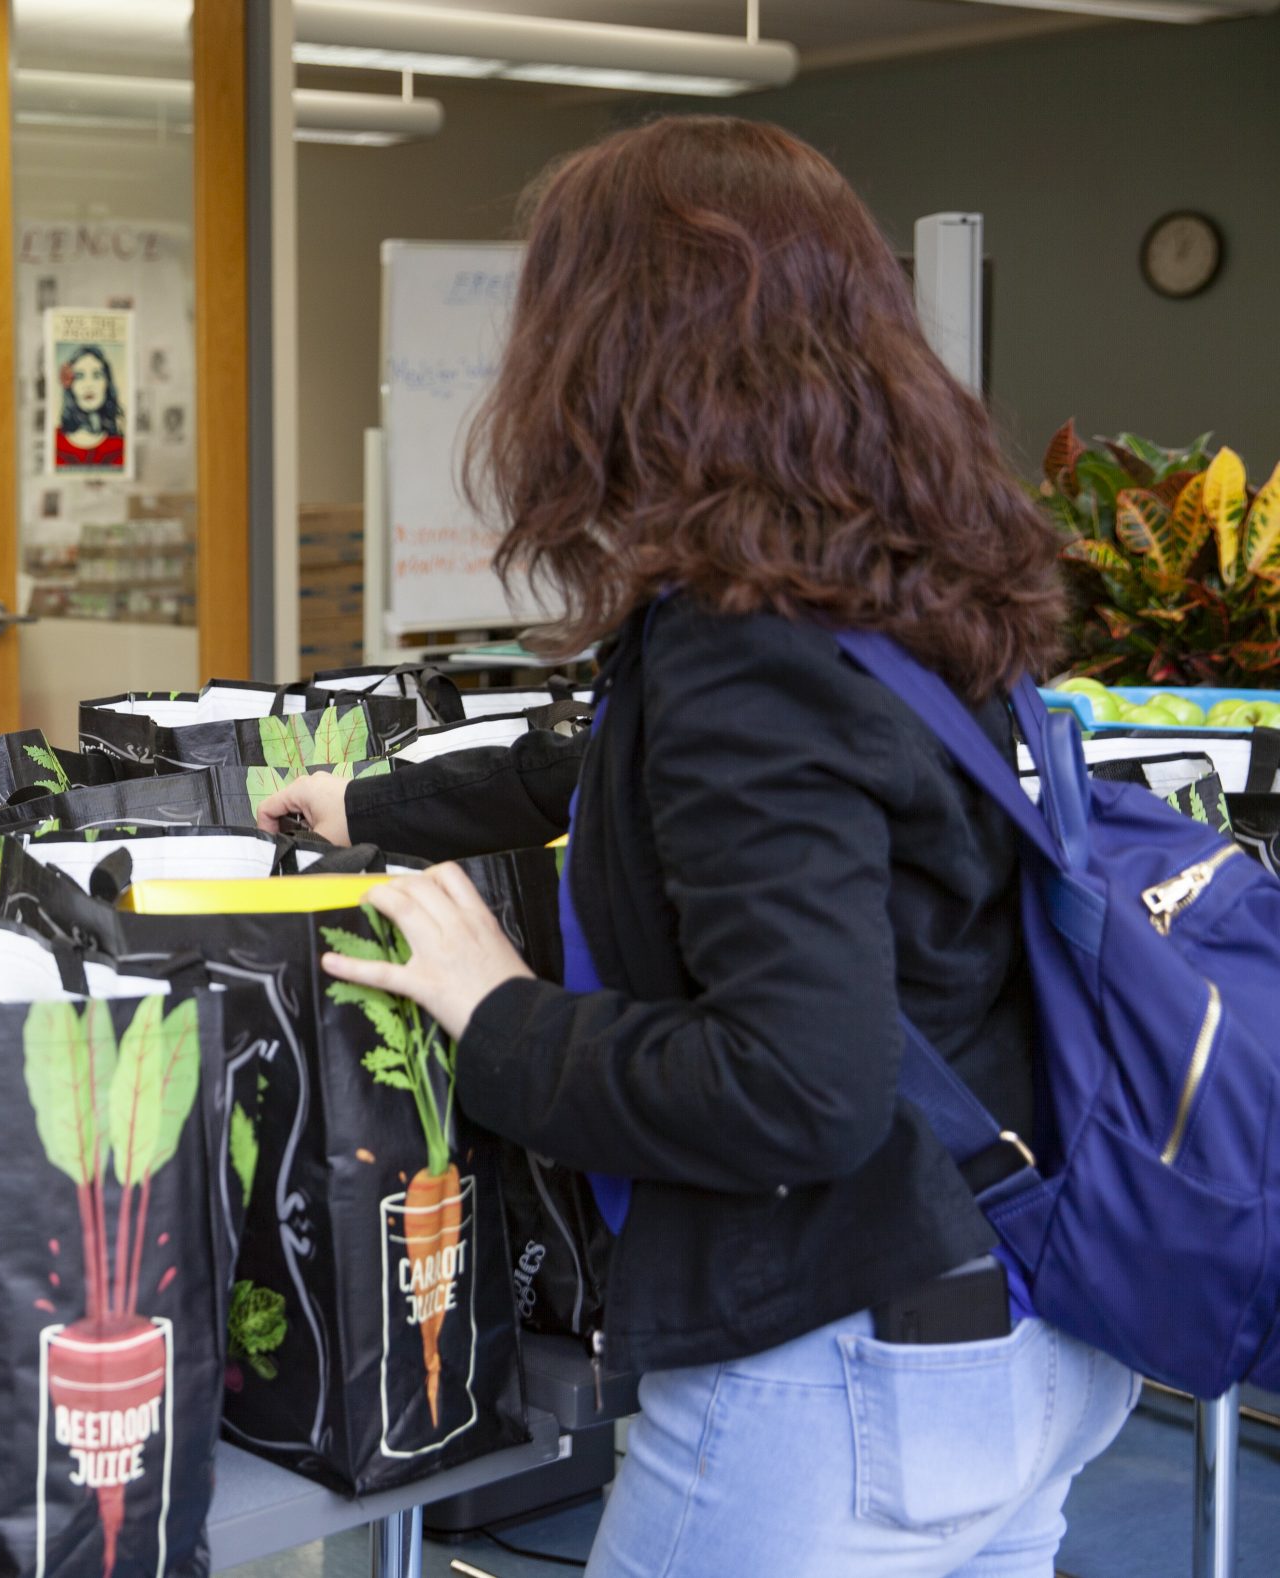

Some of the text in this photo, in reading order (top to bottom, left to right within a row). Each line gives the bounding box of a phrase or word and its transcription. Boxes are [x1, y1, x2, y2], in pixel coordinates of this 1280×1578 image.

[399, 1239, 467, 1293] CARROT
[407, 1281, 457, 1325] JUICE
[55, 1396, 161, 1448] BEETROOT
[69, 1444, 146, 1488] JUICE
